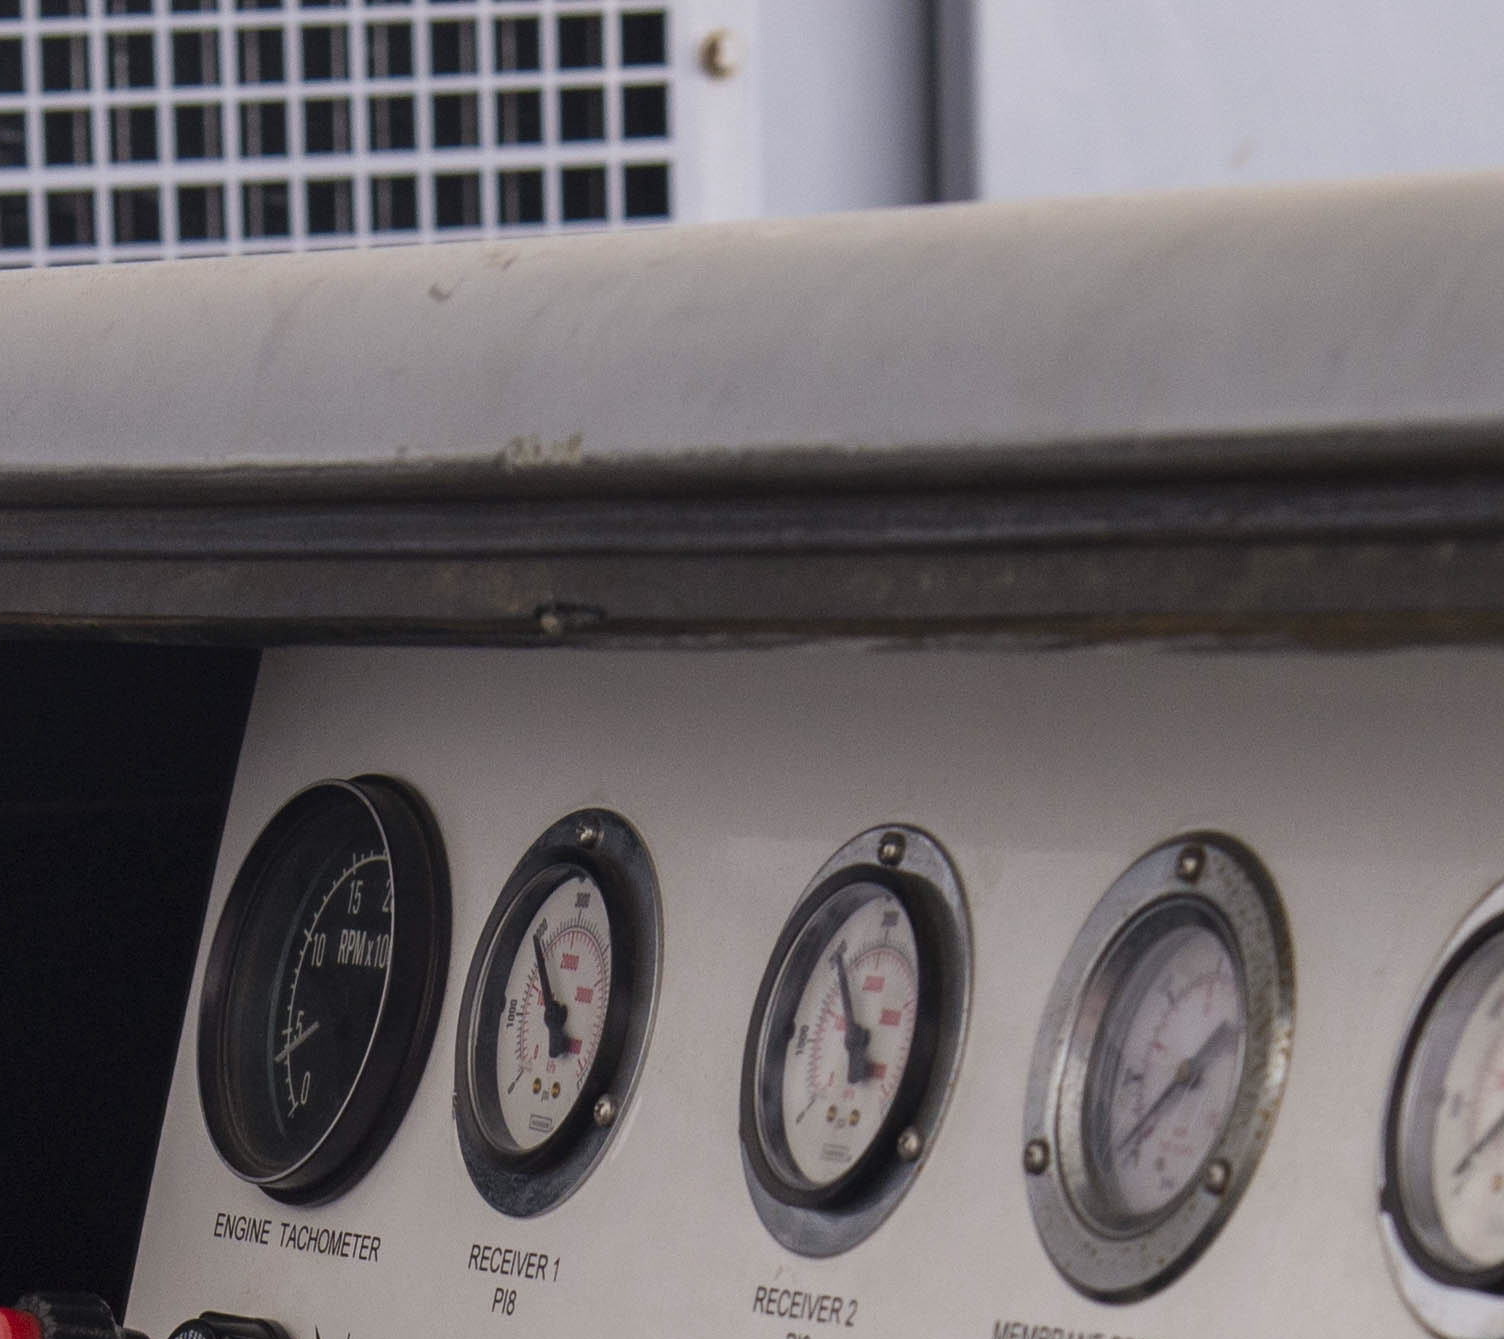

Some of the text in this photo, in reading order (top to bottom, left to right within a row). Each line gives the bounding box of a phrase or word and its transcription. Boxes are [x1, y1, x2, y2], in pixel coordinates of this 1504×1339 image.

[345, 880, 364, 916] 15
[310, 933, 327, 968] 10
[506, 998, 518, 1029] 1000
[213, 1212, 381, 1262] ENGINE TACHOMETER
[467, 1244, 561, 1282] RECEIVER 1
[752, 1285, 858, 1328] RECEIVER 2
